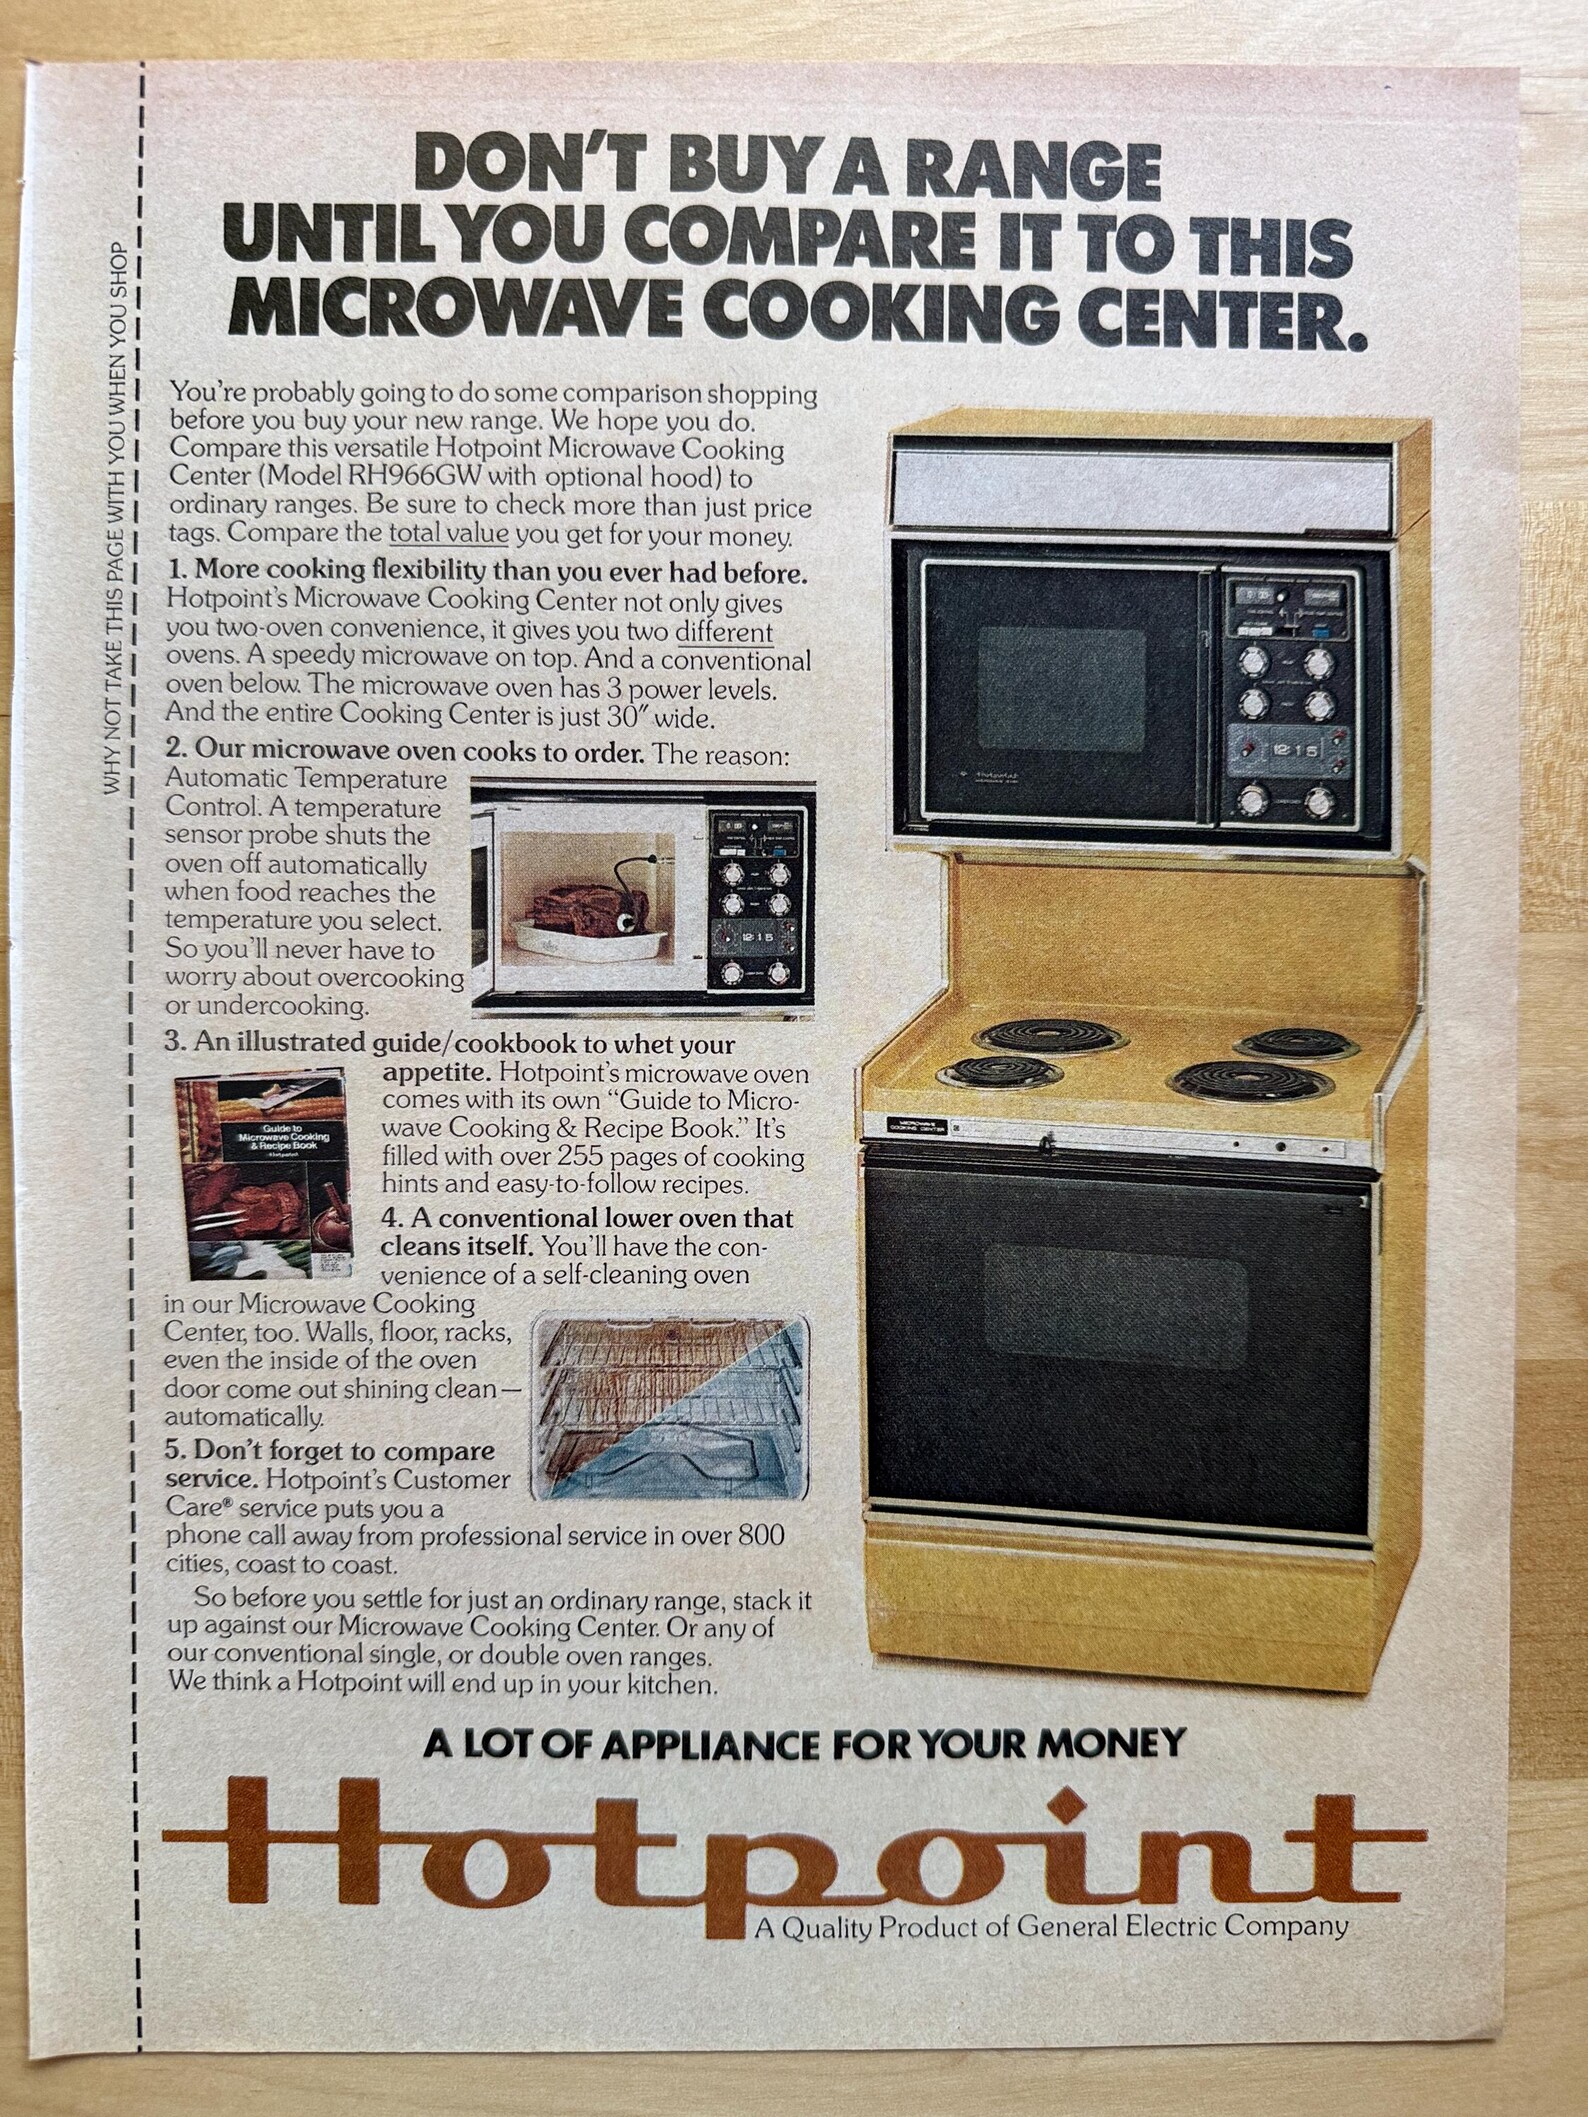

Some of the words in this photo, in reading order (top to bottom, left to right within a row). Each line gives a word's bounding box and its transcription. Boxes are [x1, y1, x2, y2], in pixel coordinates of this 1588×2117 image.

[415, 128, 647, 192] DON'T
[669, 133, 826, 194] BUY
[832, 136, 890, 196] A
[906, 138, 1162, 202] RANGE
[223, 202, 436, 263] UNTIL
[443, 202, 605, 264] YOU
[624, 204, 976, 269] COMPARE
[999, 212, 1062, 271] IT
[1077, 213, 1175, 274] TO
[1189, 216, 1354, 279] THIS
[109, 241, 128, 299] SHOP
[108, 303, 128, 349] YOU
[227, 275, 684, 338] MICROWAVE
[703, 278, 1061, 346] COOKING
[1078, 286, 1369, 353] CENTER.
[107, 353, 127, 417] WHEN
[168, 377, 247, 403] You're
[252, 379, 356, 408] probably
[359, 382, 427, 408] going
[430, 383, 454, 403] to
[458, 379, 490, 403] do
[493, 386, 558, 403] some
[562, 383, 703, 408] comparison
[707, 381, 818, 411] shopping
[107, 420, 126, 466] YOU
[169, 434, 282, 463] Compare
[287, 434, 329, 458] this
[333, 435, 430, 458] versatile
[435, 433, 543, 463] Hotpoint
[548, 434, 676, 460] Microwave
[681, 436, 785, 466] Cooking
[168, 462, 253, 486] Center
[257, 462, 342, 489] (Model
[348, 461, 483, 487] RH966GW
[487, 462, 537, 486] with
[545, 463, 643, 493] optional
[650, 463, 722, 492] hood)
[729, 468, 754, 490] to
[106, 471, 125, 525] WITH
[105, 528, 124, 583] PAGE
[168, 557, 188, 580] 1.
[194, 556, 260, 580] More
[264, 556, 366, 585] cooking
[371, 555, 488, 586] flexibility
[492, 557, 551, 582] than
[556, 565, 603, 587] you
[608, 566, 664, 584] ever
[668, 559, 718, 584] had
[723, 560, 808, 585] before.
[105, 587, 124, 636] THIS
[166, 584, 289, 614] Hotpoint's
[293, 582, 421, 609] Microwave
[427, 585, 530, 616] Cooking
[535, 587, 618, 612] Center
[623, 592, 664, 613] not
[668, 589, 720, 620] only
[725, 593, 783, 619] gives
[104, 640, 123, 693] TAKE
[103, 696, 122, 741] NOT
[164, 734, 188, 758] 2.
[194, 735, 247, 759] Our
[251, 737, 391, 761] microwave
[396, 744, 457, 762] oven
[462, 739, 537, 763] cooks
[542, 743, 569, 763] to
[574, 740, 645, 765] order.
[650, 741, 699, 766] The
[704, 749, 790, 767] reason:
[101, 745, 121, 796] WHY
[164, 765, 289, 789] Automatic
[293, 765, 448, 795] Temperature
[164, 910, 313, 935] temperature
[317, 915, 364, 936] you
[369, 908, 442, 932] select.
[164, 999, 192, 1016] or
[196, 992, 370, 1021] undercooking.
[163, 1028, 188, 1052] 3.
[192, 1028, 231, 1052] An
[236, 1029, 367, 1053] illustrated
[372, 1029, 578, 1059] guide/cookbook
[582, 1035, 608, 1055] to
[613, 1032, 675, 1055] whet
[679, 1039, 737, 1060] your
[382, 1061, 492, 1087] appetite.
[499, 1059, 620, 1088] Hotpoint's
[625, 1063, 749, 1084] microwave
[753, 1068, 810, 1085] oven
[238, 1133, 289, 1142] Microwave
[290, 1132, 330, 1143] Cooking
[262, 1124, 292, 1133] Guide
[292, 1125, 303, 1133] to
[259, 1141, 292, 1151] Recipe
[292, 1141, 318, 1150] Book
[380, 1206, 404, 1228] 4.
[410, 1205, 433, 1229] A
[438, 1205, 599, 1229] conventional
[604, 1205, 674, 1229] lower
[678, 1212, 738, 1229] oven
[742, 1206, 795, 1229] that
[163, 1293, 185, 1314] in
[191, 1298, 234, 1314] our
[238, 1291, 367, 1315] Microwave
[372, 1291, 476, 1319] Cooking
[163, 1437, 187, 1461] 5.
[193, 1437, 264, 1461] Don't
[268, 1437, 344, 1467] forget
[350, 1441, 376, 1462] to
[383, 1444, 496, 1468] compare
[164, 1467, 259, 1489] service.
[265, 1466, 387, 1496] Hotpoint's
[392, 1467, 512, 1491] Customer
[165, 1521, 242, 1550] phone
[247, 1523, 287, 1546] call
[291, 1530, 353, 1552] away
[357, 1523, 414, 1547] from
[419, 1522, 563, 1552] professional
[567, 1525, 648, 1547] service
[654, 1525, 675, 1547] in
[681, 1529, 733, 1547] over
[738, 1522, 786, 1547] 800
[167, 1668, 207, 1692] We
[211, 1668, 273, 1692] think
[276, 1676, 292, 1693] a
[297, 1668, 404, 1699] Hotpoint
[407, 1670, 446, 1694] will
[451, 1671, 497, 1695] end
[503, 1678, 534, 1700] up
[540, 1673, 561, 1695] in
[567, 1678, 622, 1700] your
[627, 1671, 718, 1696] kitchen.
[422, 1727, 454, 1758] A
[464, 1727, 535, 1759] LOT
[540, 1728, 593, 1760] OF
[600, 1729, 820, 1762] APPLIANCE
[833, 1728, 912, 1761] FOR
[917, 1728, 1027, 1760] YOUR
[1036, 1726, 1188, 1759] MONEY
[162, 1776, 1427, 1940] Hotpoint
[754, 1916, 776, 1940] A
[782, 1915, 873, 1945] Quality
[879, 1914, 978, 1940] Product
[985, 1913, 1011, 1939] of
[1017, 1913, 1118, 1938] General
[1125, 1913, 1217, 1938] Electric
[1224, 1912, 1350, 1942] Company
